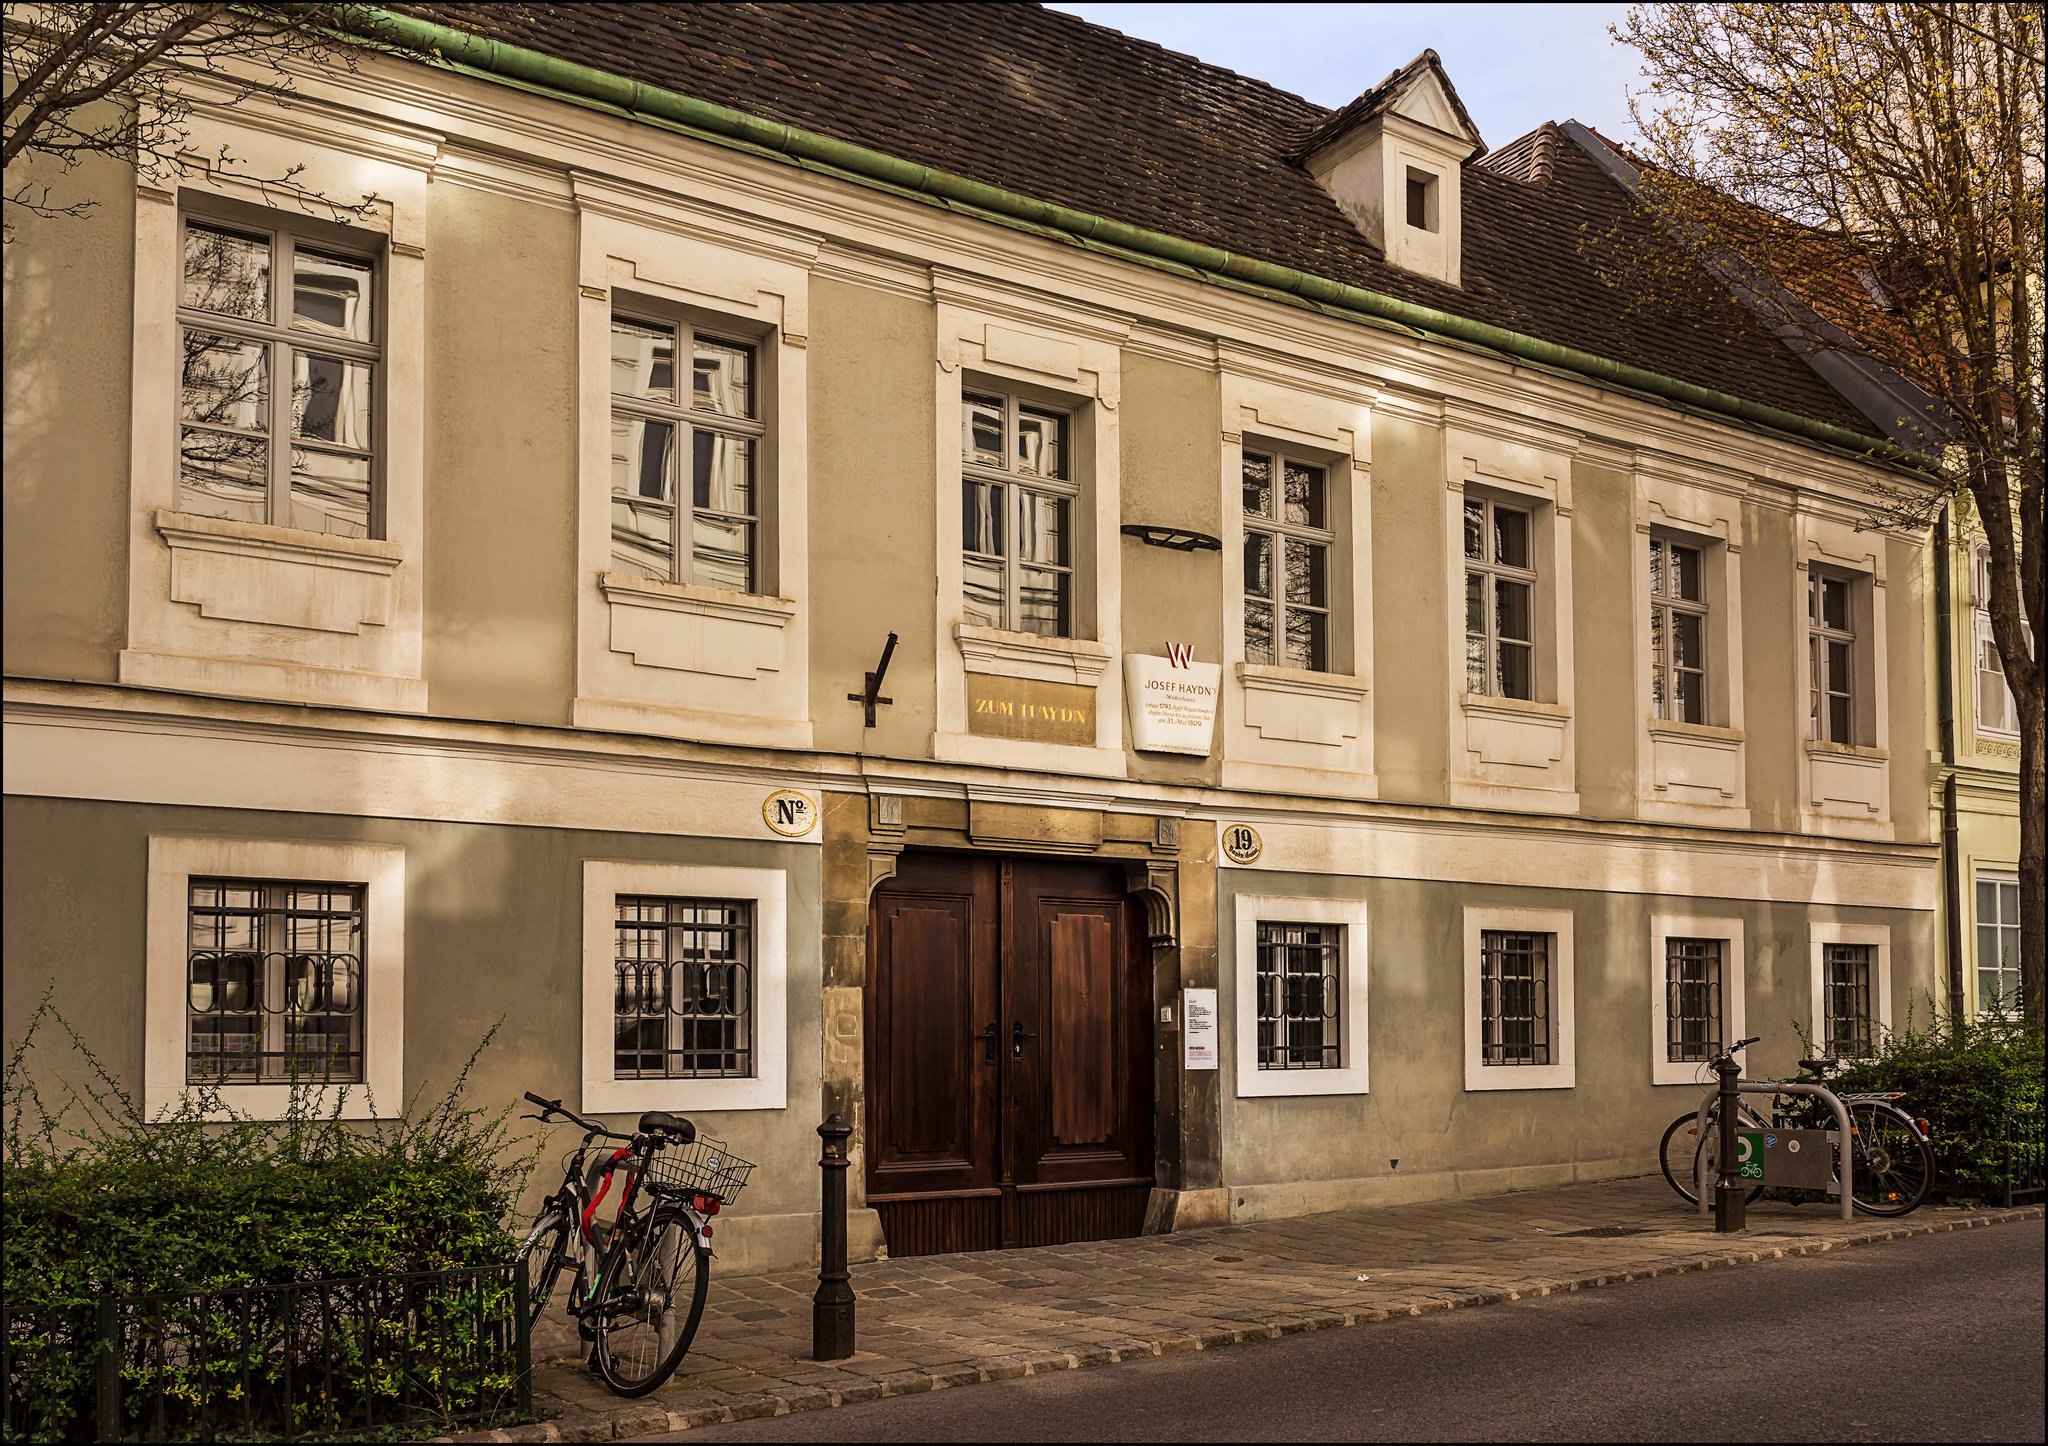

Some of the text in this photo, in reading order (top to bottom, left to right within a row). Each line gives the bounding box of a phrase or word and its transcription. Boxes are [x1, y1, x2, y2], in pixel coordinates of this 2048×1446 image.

[1165, 641, 1195, 670] W
[1144, 680, 1176, 692] JOSEF
[975, 698, 1086, 725] ZUM HAYDN
[1233, 828, 1253, 850] 19
